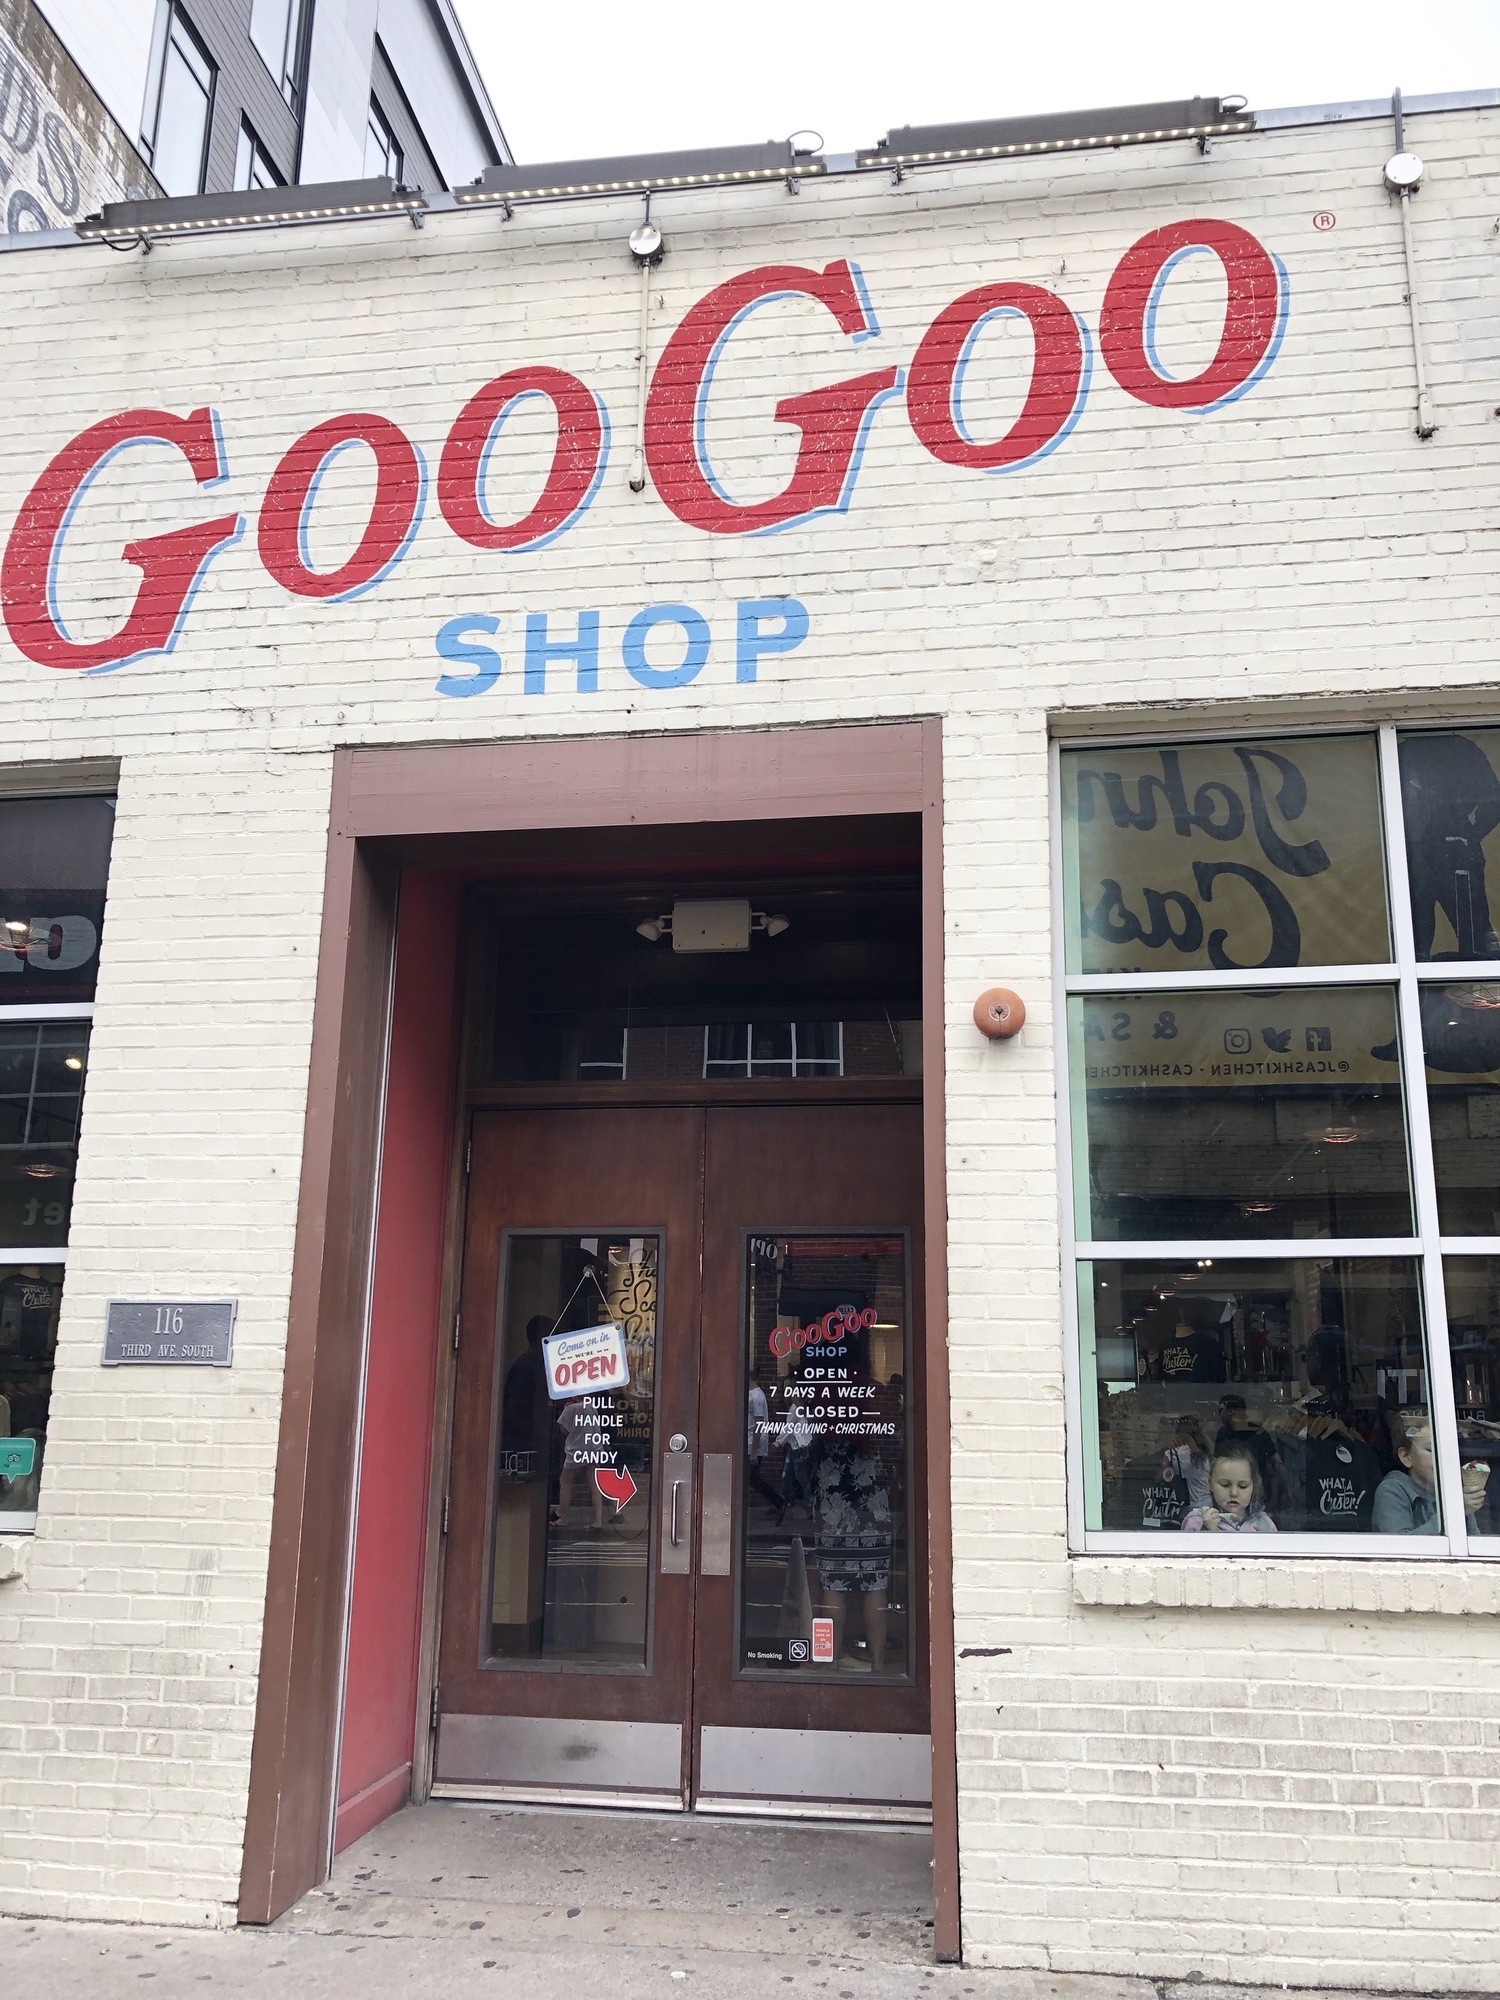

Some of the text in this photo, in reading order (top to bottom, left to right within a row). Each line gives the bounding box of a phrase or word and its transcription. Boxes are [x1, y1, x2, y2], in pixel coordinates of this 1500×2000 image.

[436, 596, 808, 697] SHOP
[154, 1307, 184, 1335] 116
[557, 1332, 611, 1357] Come on in
[121, 1344, 215, 1359] THIRD AVE. SOUTH
[805, 1346, 848, 1357] SHOP
[554, 1353, 618, 1387] OPEN
[803, 1367, 848, 1379] OPEN
[769, 1386, 876, 1399] 7 DAYS A WEEK
[583, 1396, 615, 1409] PULL
[795, 1406, 859, 1418] CLOSED
[575, 1414, 623, 1427] HANDLE
[835, 1423, 896, 1435] CHRISTMAS
[584, 1433, 611, 1445] FOR
[573, 1450, 618, 1464] CANDY
[1319, 1477, 1353, 1491] WHAT A
[1142, 1486, 1170, 1498] WHAT
[747, 1651, 783, 1661] No Smoking
